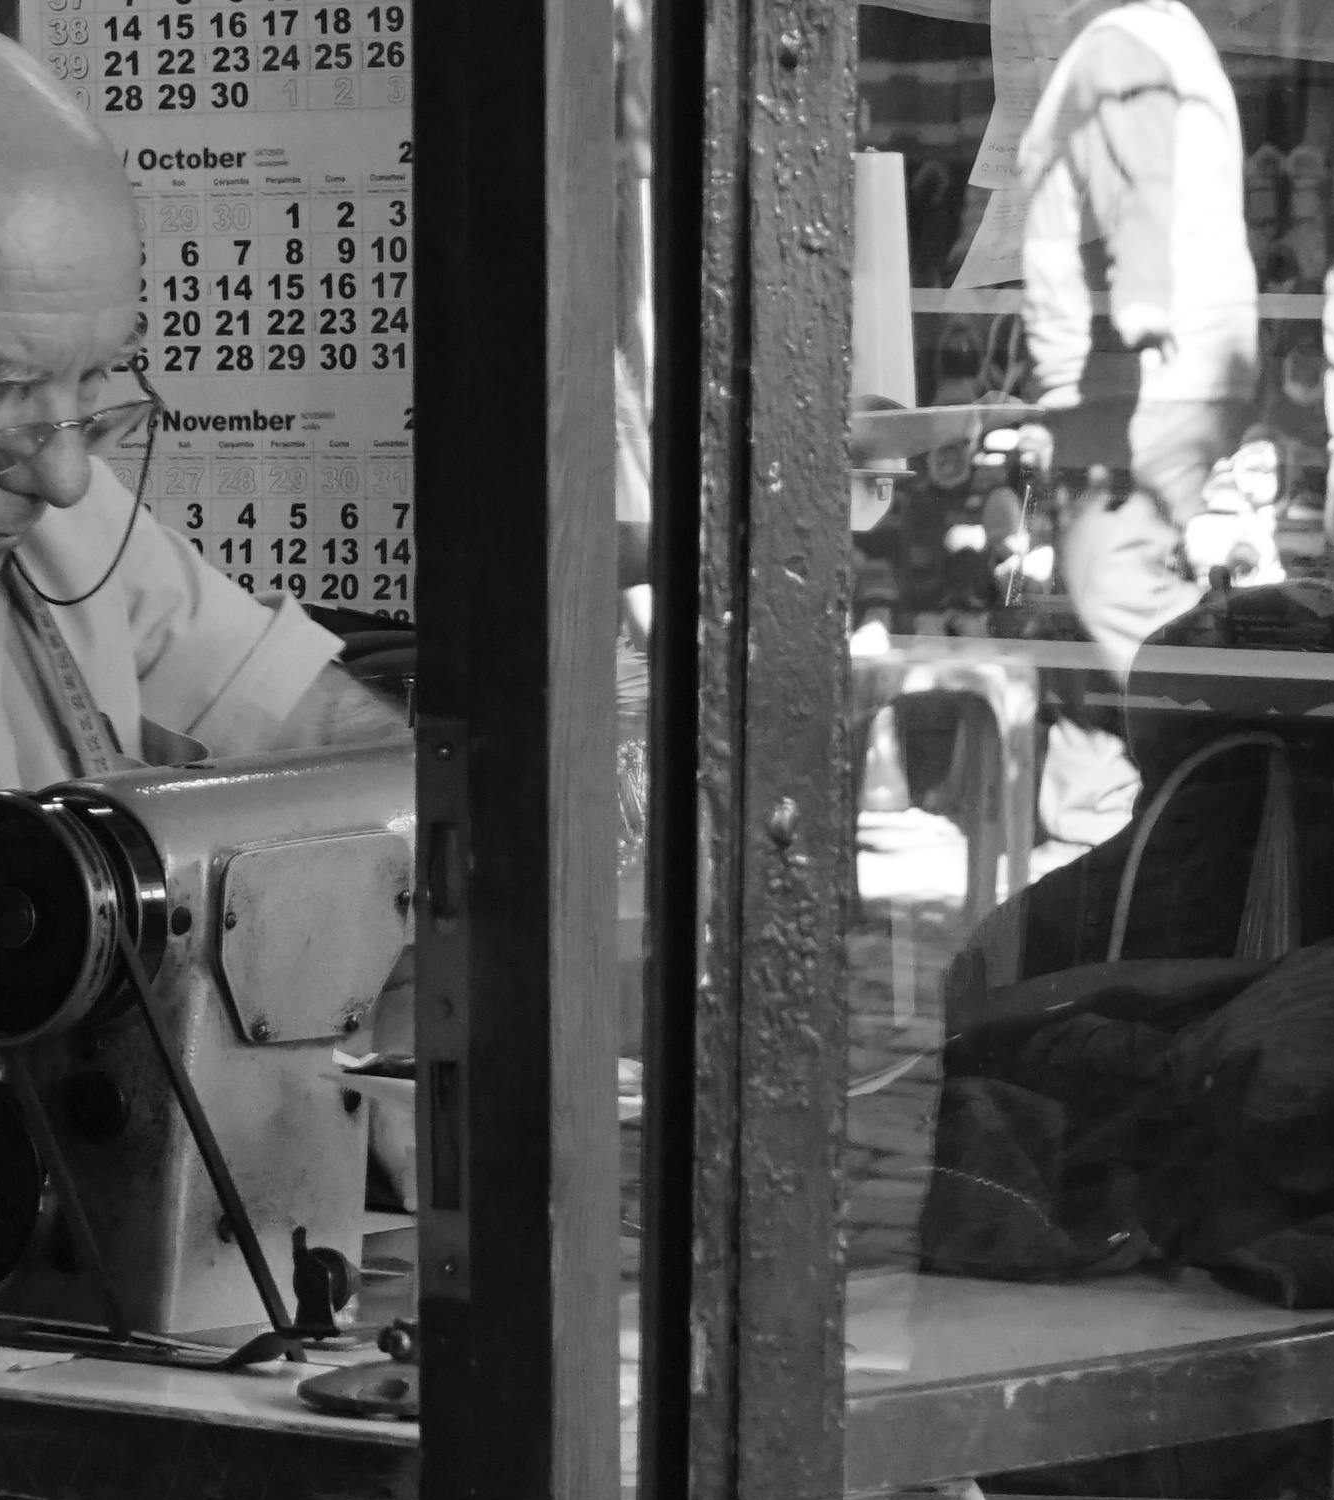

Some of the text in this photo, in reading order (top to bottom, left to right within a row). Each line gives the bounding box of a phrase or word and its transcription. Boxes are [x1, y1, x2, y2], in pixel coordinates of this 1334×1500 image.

[48, 6, 404, 45] 38 14 15 16 17 18 19
[105, 51, 138, 76] 21
[158, 49, 195, 75] 22
[213, 46, 250, 72] 23
[263, 45, 300, 71] 24
[315, 43, 352, 69] 25
[368, 41, 404, 68] 26
[105, 85, 142, 111] 28
[159, 84, 195, 109] 29
[212, 82, 248, 108] 30
[138, 147, 246, 170] October
[286, 203, 299, 228] 1
[338, 202, 354, 227] 2
[390, 200, 406, 226] 3
[182, 236, 407, 266] 6 7 8 9 10
[164, 272, 407, 301] 13 14 15 16 17
[164, 307, 409, 336] 20 21 22 23 24
[165, 343, 405, 371] 27 28 29 30 31
[162, 409, 295, 432] November
[187, 503, 410, 529] 3 4 5 6 7
[220, 538, 411, 565] 11 12 13 14
[271, 574, 407, 600] 19 20 21
